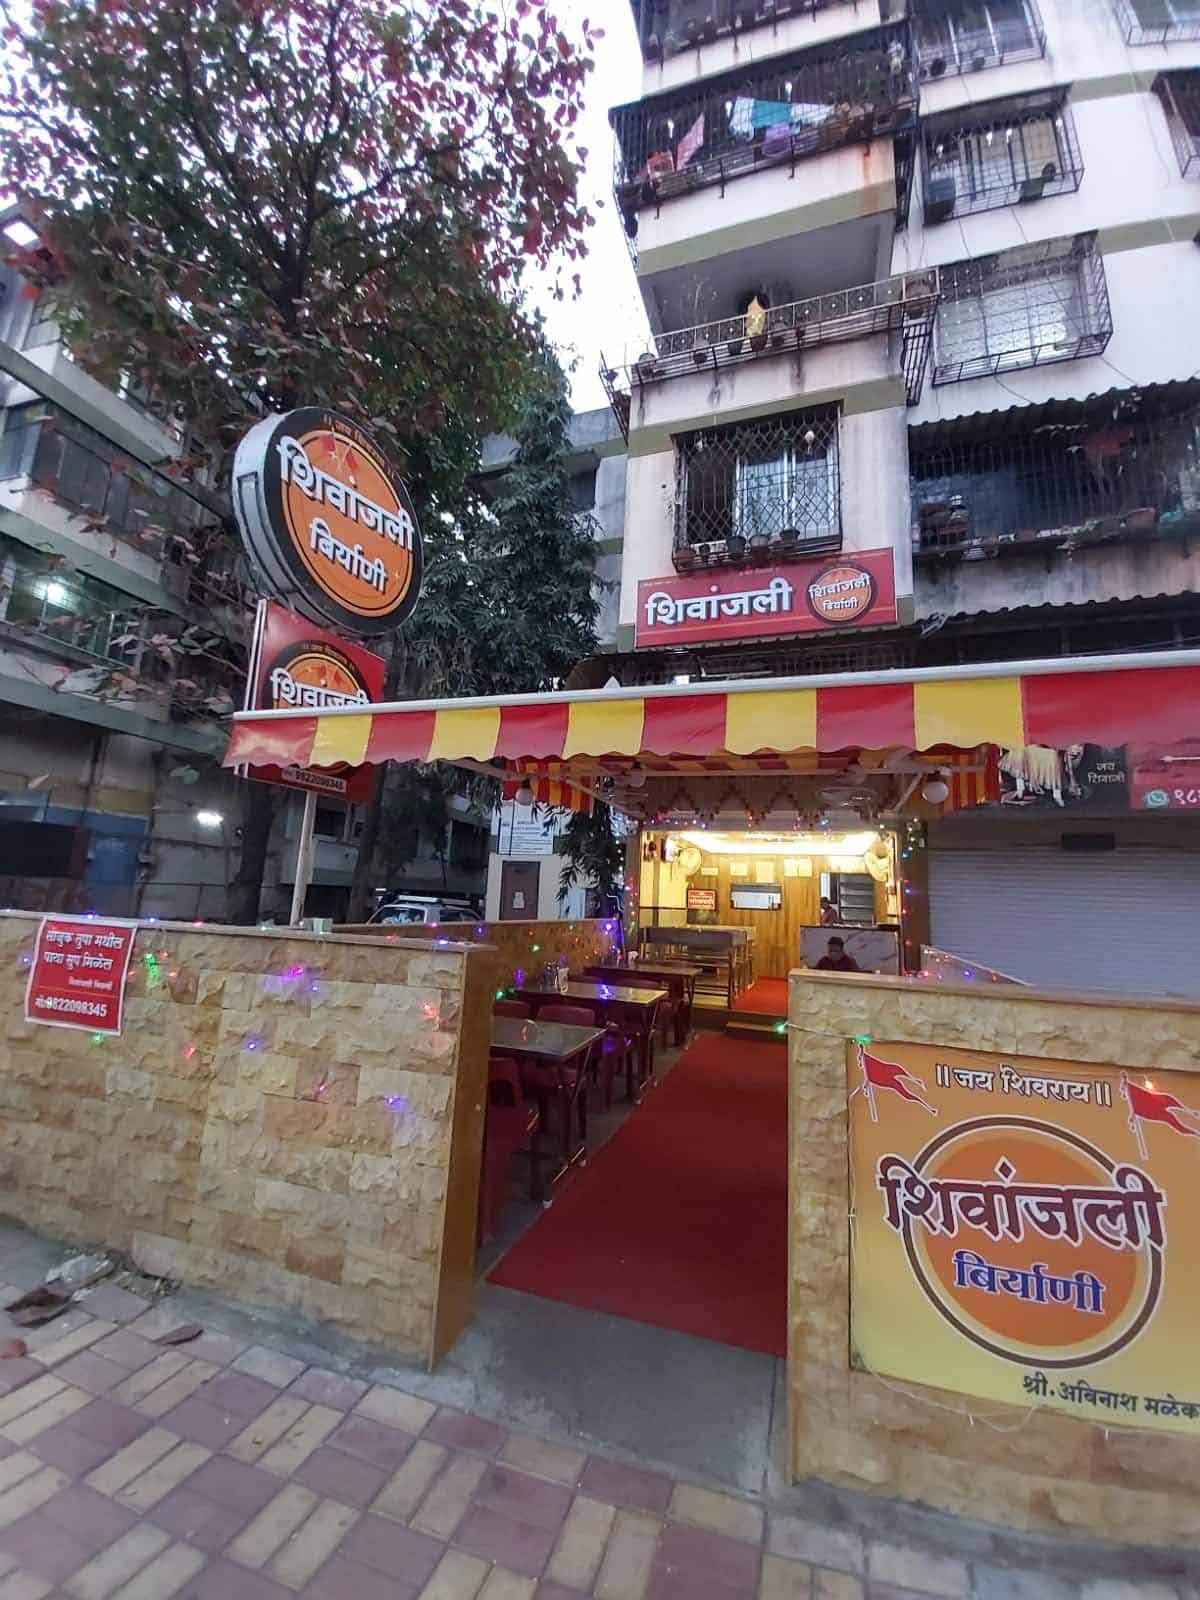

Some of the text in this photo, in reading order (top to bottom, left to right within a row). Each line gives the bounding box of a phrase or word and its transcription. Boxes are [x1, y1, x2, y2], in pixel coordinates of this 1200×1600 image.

[276, 435, 415, 552] शिवांजली
[309, 517, 388, 594] बिर्याणी
[808, 572, 871, 600] शिवांजली
[645, 577, 793, 625] शिवांजली
[876, 1154, 1168, 1250] शिवांजली
[953, 1250, 1105, 1314] बिर्याणी
